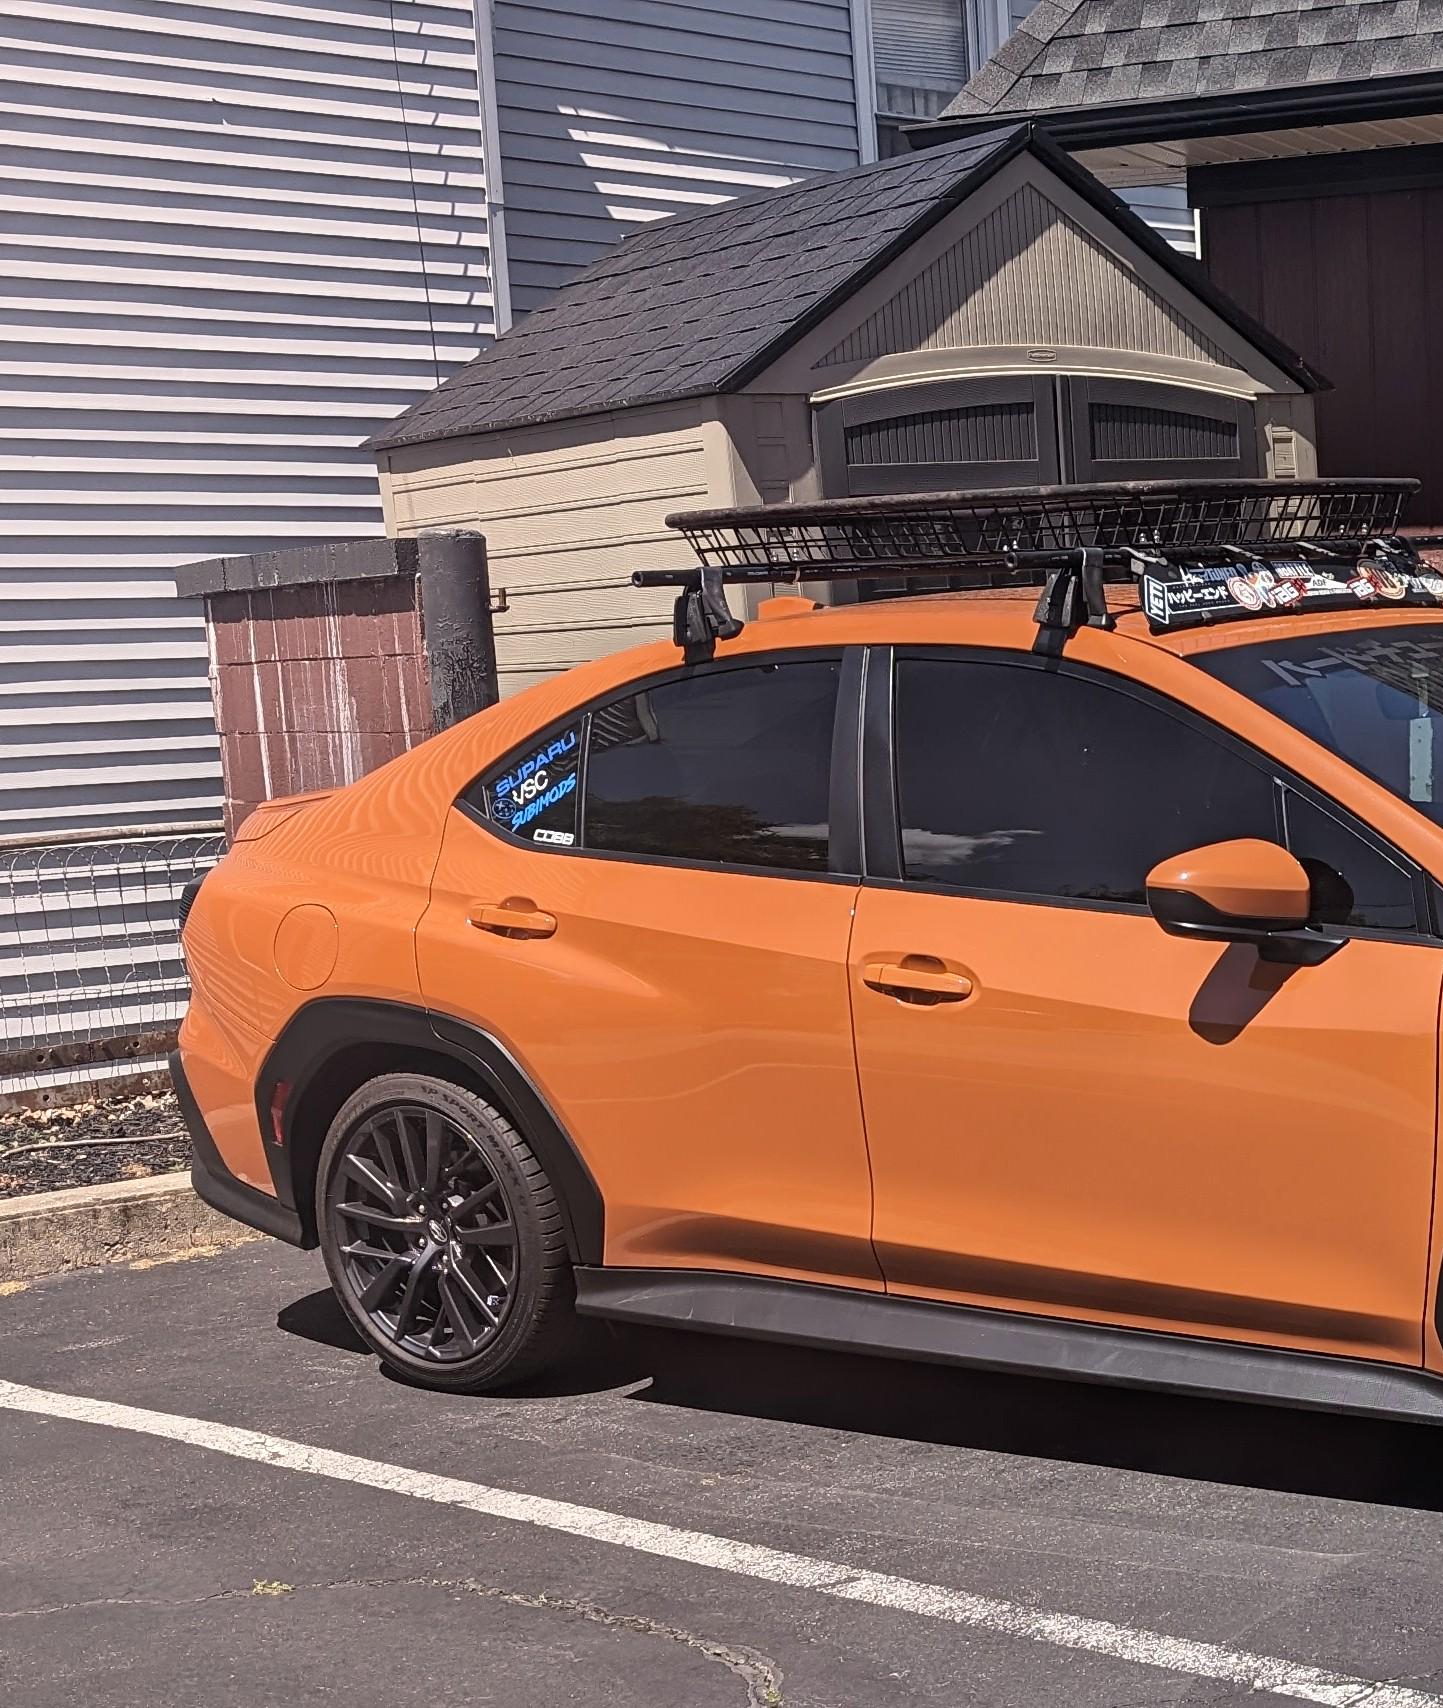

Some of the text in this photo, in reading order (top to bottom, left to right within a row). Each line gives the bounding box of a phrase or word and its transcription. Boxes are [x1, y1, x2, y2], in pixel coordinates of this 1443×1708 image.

[1149, 580, 1164, 616] YETI
[1167, 586, 1229, 605] ハッピーエンド
[512, 770, 548, 805] VSC
[512, 772, 576, 832] SUBIMODS
